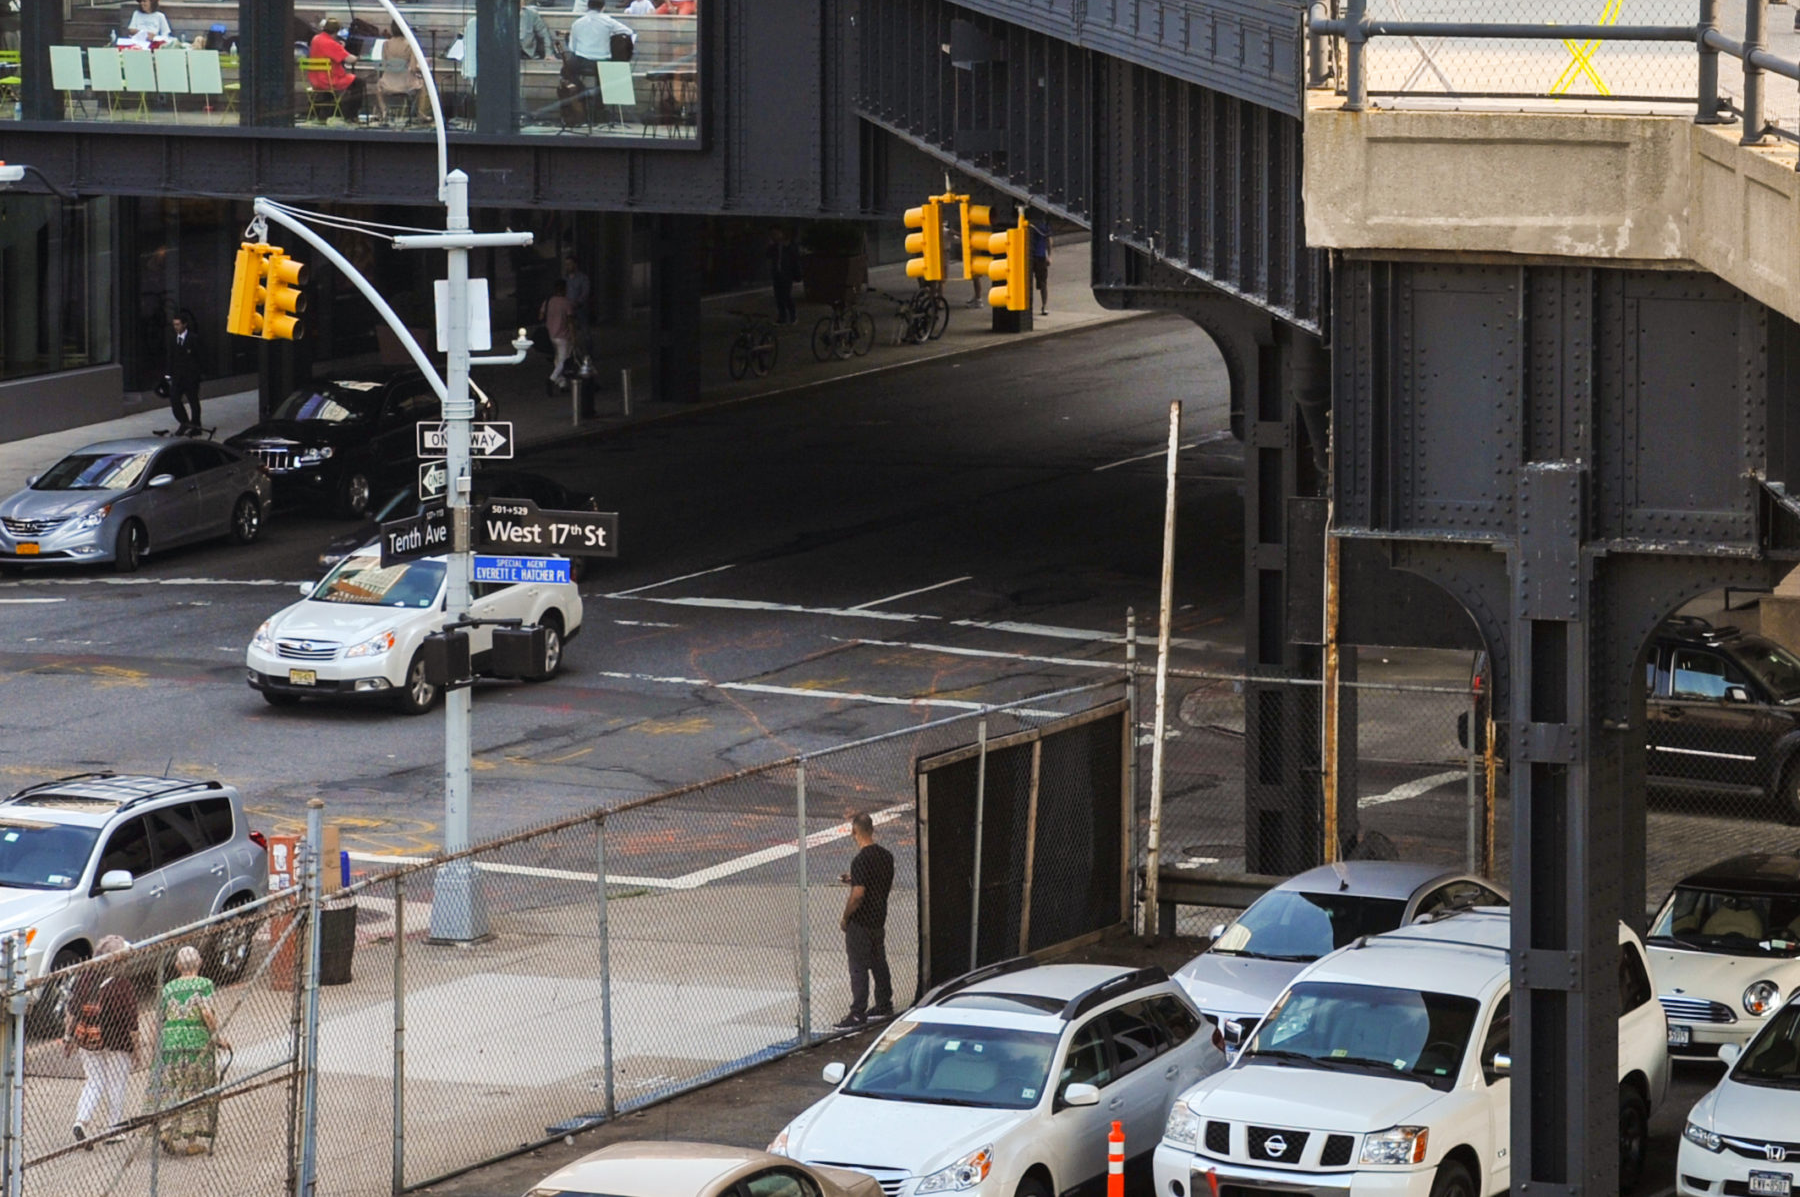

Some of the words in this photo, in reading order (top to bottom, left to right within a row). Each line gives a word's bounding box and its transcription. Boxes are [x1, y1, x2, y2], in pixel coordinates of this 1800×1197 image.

[432, 433, 448, 447] ON
[469, 433, 497, 447] WAY
[428, 472, 443, 487] ONE
[389, 526, 422, 555] Tenth
[425, 524, 447, 546] Ave
[486, 520, 542, 544] West
[548, 523, 582, 544] 17th
[584, 524, 607, 547] St
[496, 558, 523, 568] SPECIAL
[526, 560, 547, 569] AGENT
[477, 567, 509, 580] EVERETT
[521, 569, 555, 582] HATCHER
[556, 570, 567, 582] PL
